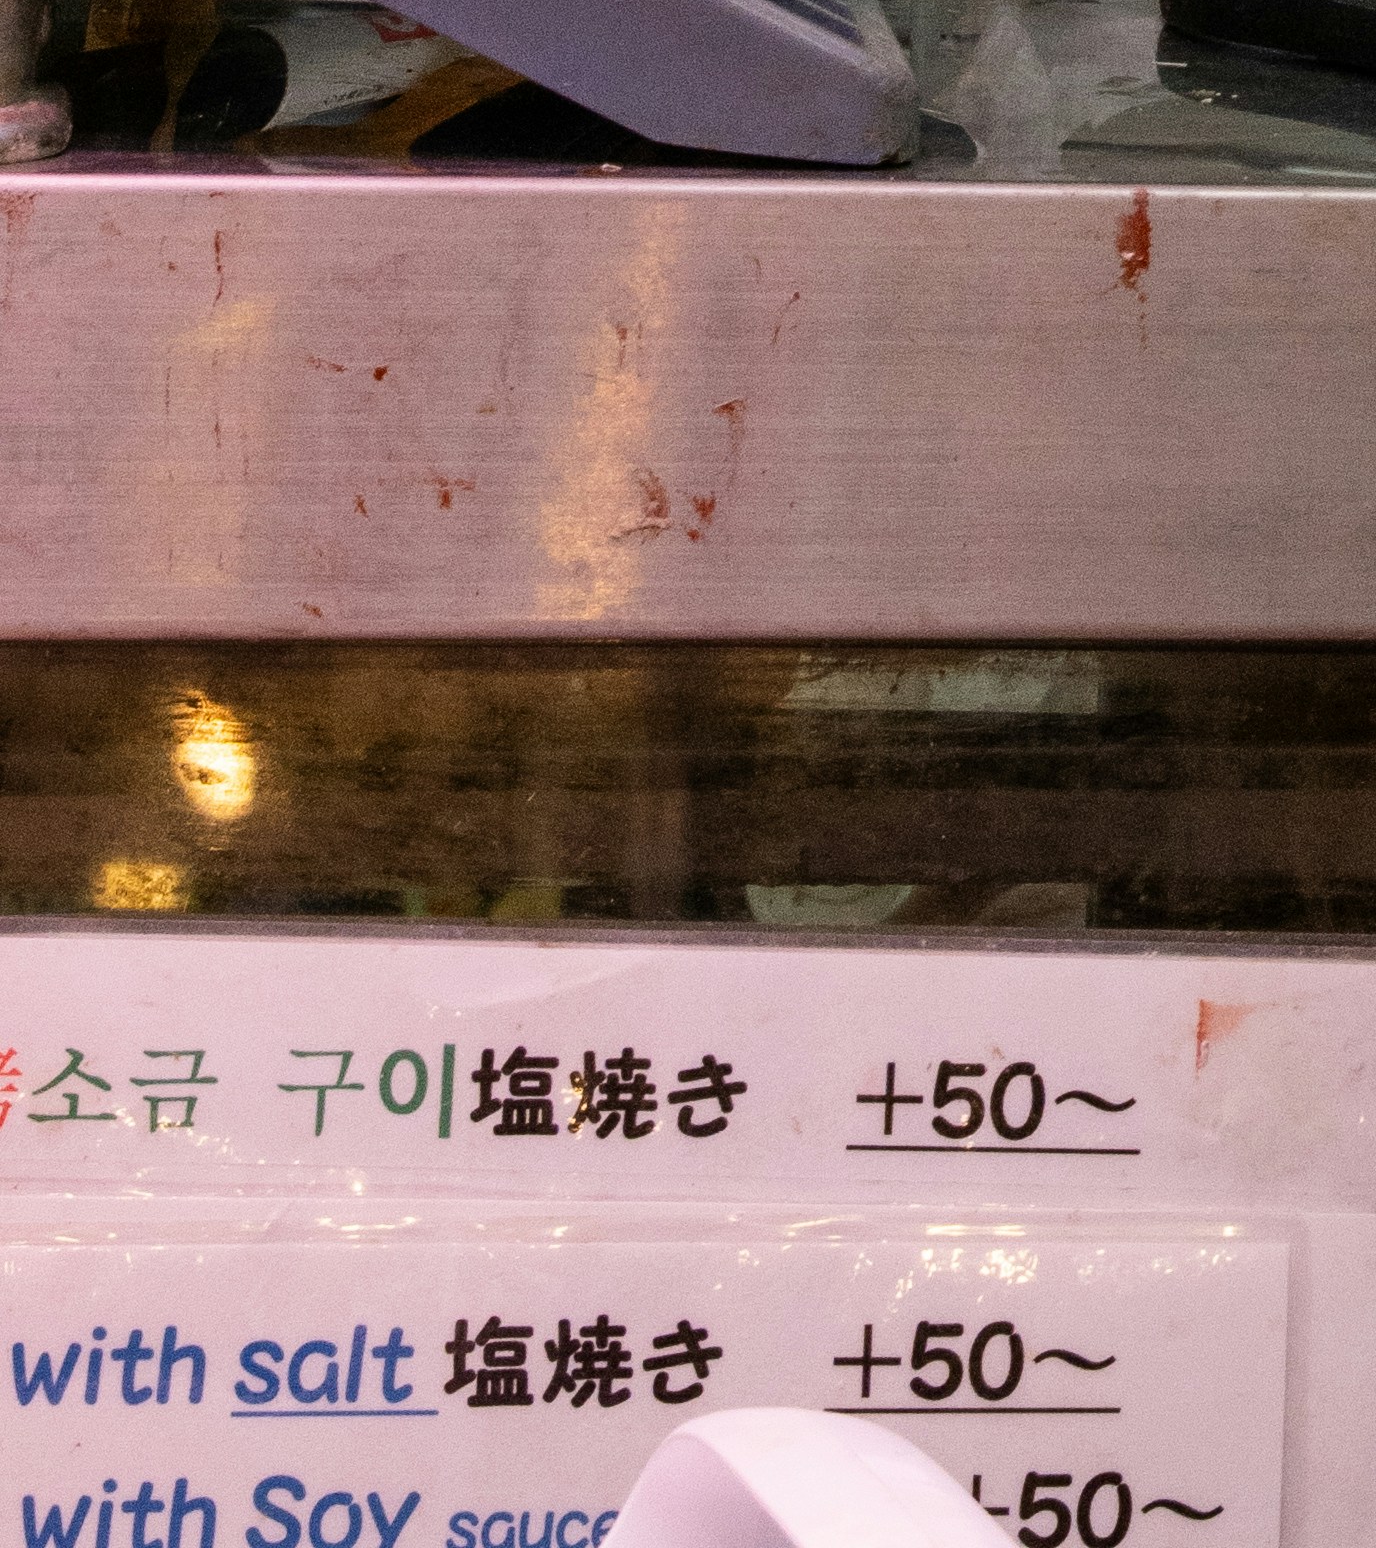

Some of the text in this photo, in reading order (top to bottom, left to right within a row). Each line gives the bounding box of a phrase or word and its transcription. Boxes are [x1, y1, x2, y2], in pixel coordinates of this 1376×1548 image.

[26, 1047, 219, 1134] 소금
[469, 1045, 748, 1140] 塩焼き
[12, 1325, 206, 1406] with
[231, 1323, 416, 1407] salt
[442, 1313, 724, 1409] 塩焼き
[22, 1477, 217, 1548] with
[245, 1474, 421, 1548] Soy
